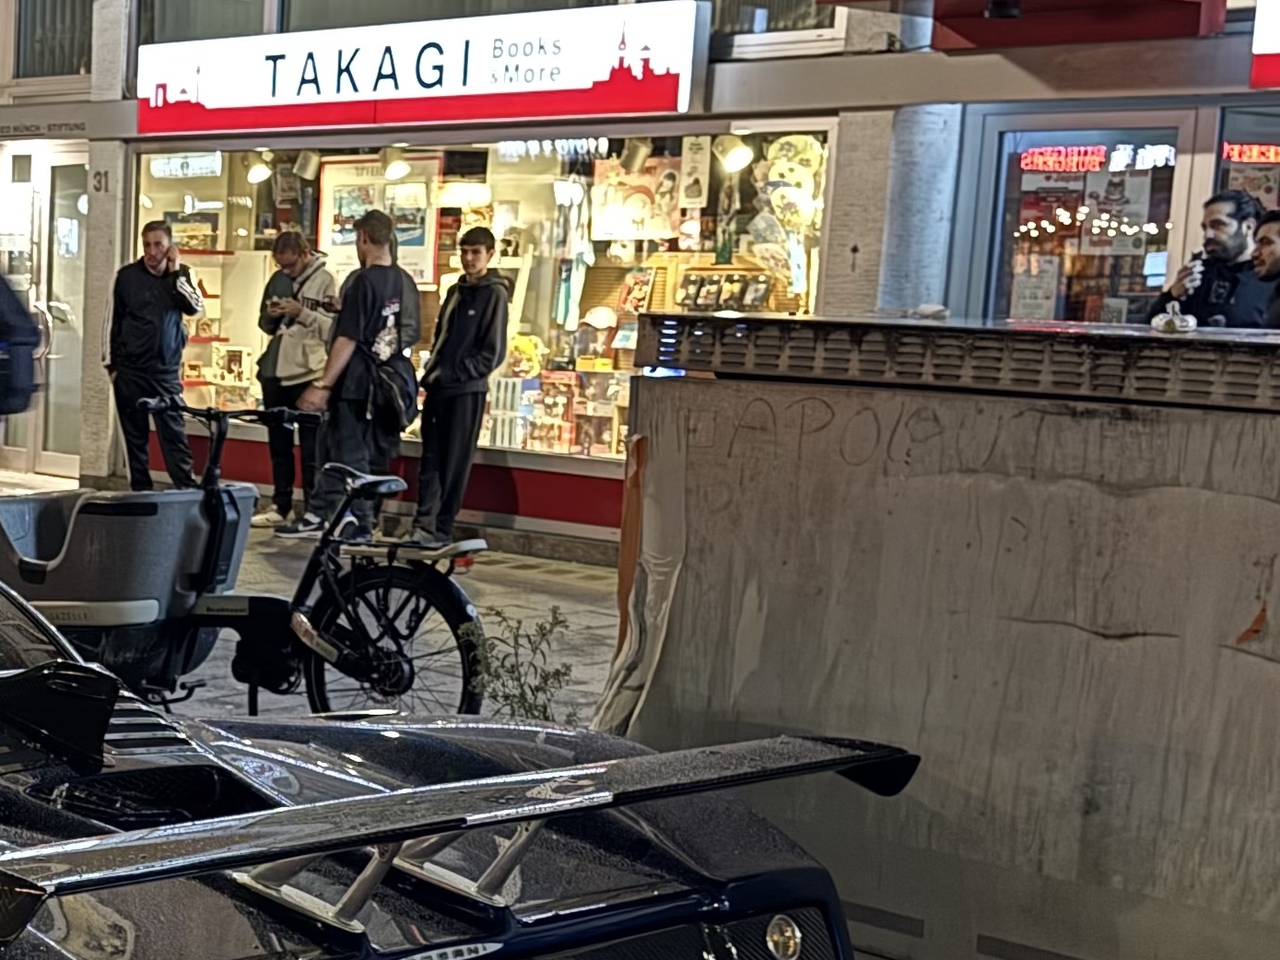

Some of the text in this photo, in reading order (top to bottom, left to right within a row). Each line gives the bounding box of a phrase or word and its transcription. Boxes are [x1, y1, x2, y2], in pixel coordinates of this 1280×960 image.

[492, 37, 561, 59] Books
[265, 40, 470, 97] TAKAGI
[93, 171, 110, 193] 31
